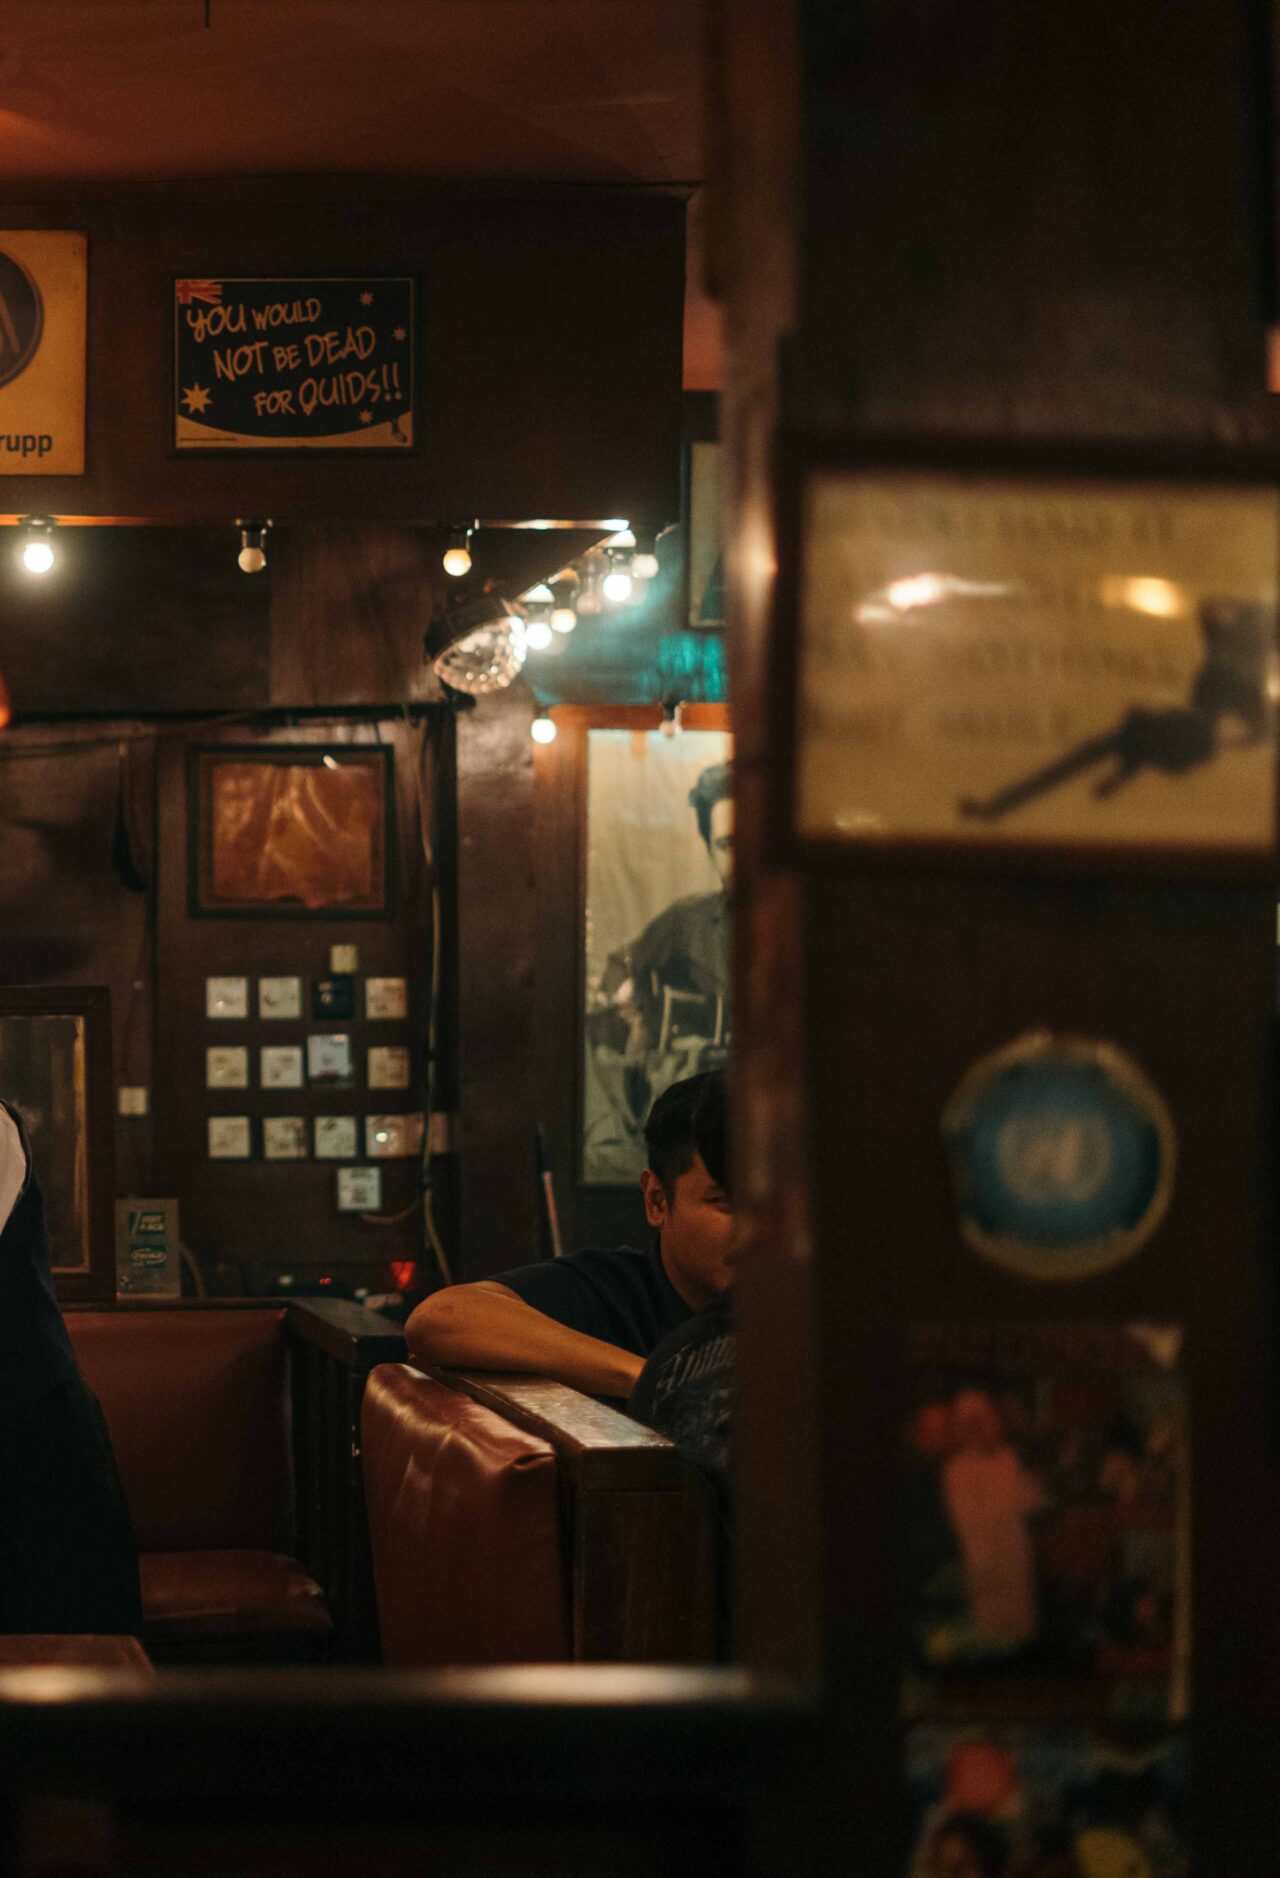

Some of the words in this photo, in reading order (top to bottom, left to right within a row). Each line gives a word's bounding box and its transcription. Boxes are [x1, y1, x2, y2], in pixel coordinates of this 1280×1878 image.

[186, 303, 247, 343] YOU
[251, 298, 322, 331] WOULD
[213, 341, 269, 382] NOT
[272, 344, 302, 372] BE
[304, 325, 377, 368] DEAD
[253, 389, 296, 417] FOR
[298, 362, 402, 416] QUIDS!!
